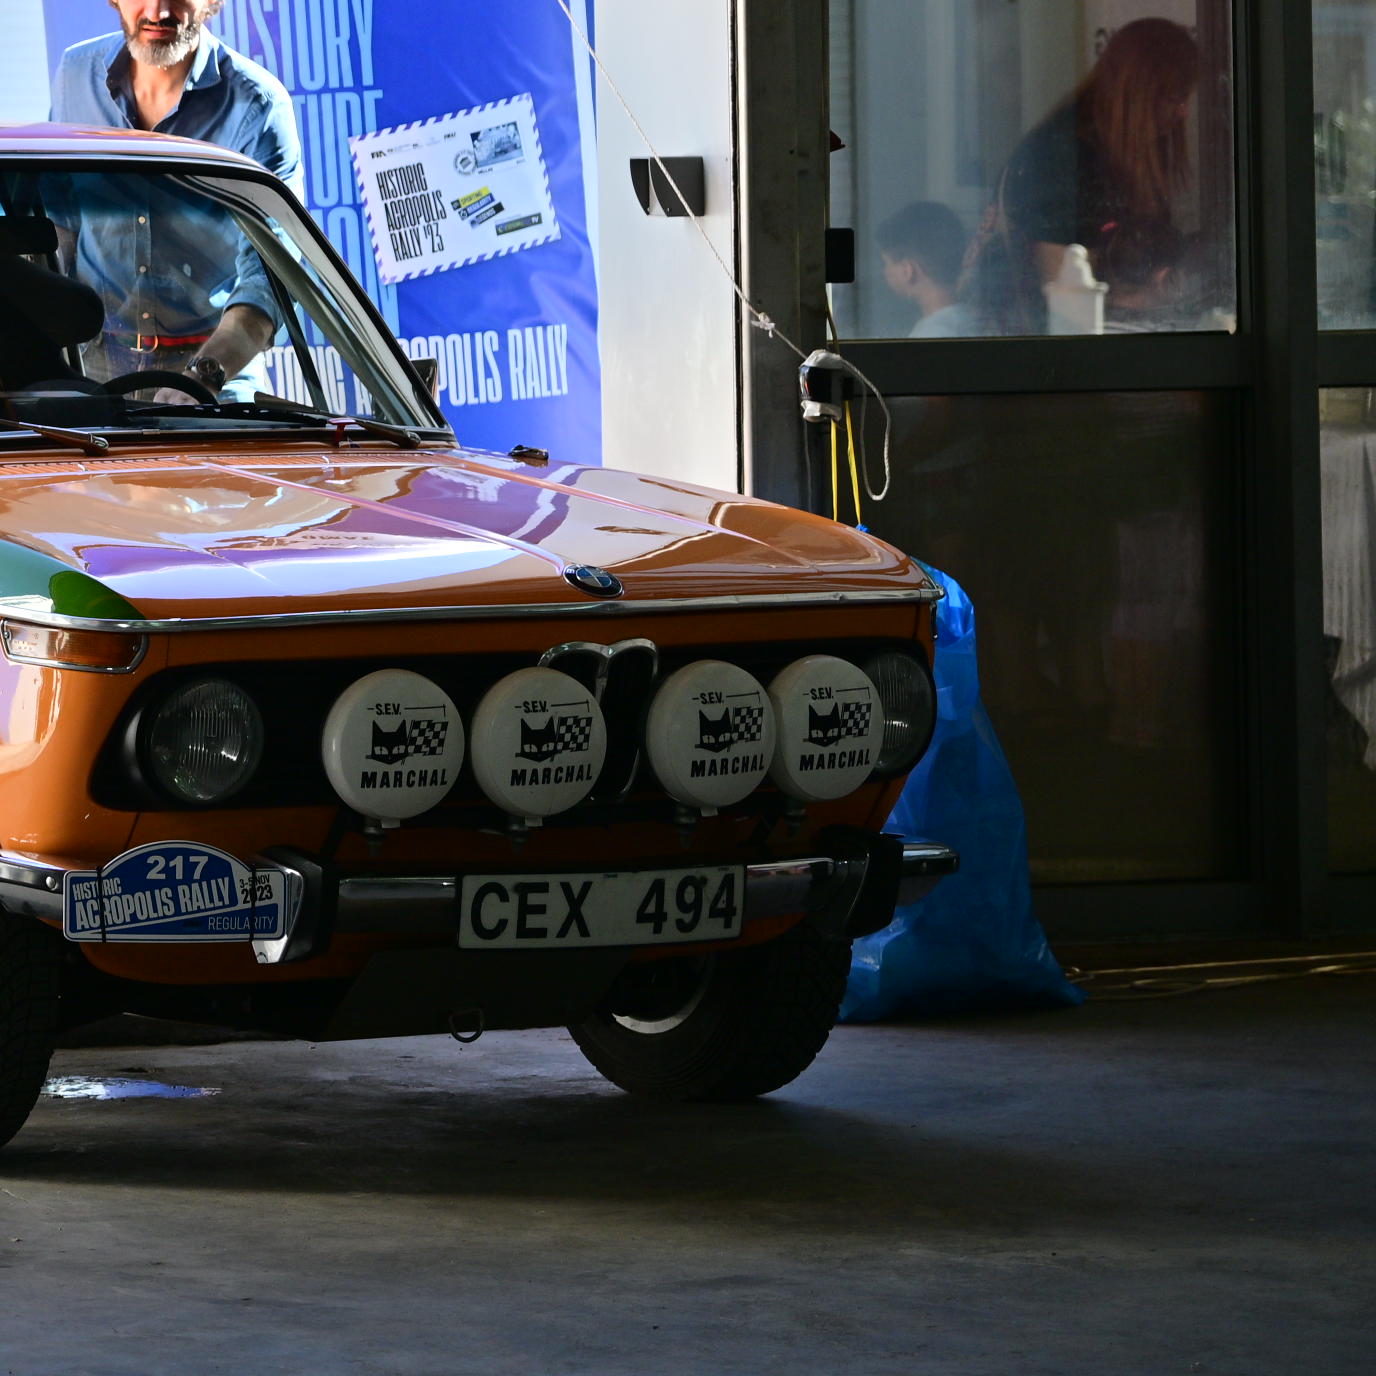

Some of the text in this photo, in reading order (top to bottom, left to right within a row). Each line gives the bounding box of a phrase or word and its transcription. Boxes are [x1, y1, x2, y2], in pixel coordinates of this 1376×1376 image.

[375, 162, 428, 201] HISTORIC
[383, 189, 447, 232] ACROPOLIS
[389, 226, 423, 263] RALLY
[507, 323, 569, 401] RALLY
[360, 768, 448, 789] MARCHAL
[510, 764, 593, 786] MARCHAL
[690, 753, 765, 778] MARCHAL
[799, 748, 870, 772] MARCHAL
[146, 855, 209, 880] 217
[178, 876, 230, 913] RALLY
[470, 873, 737, 941] CEX 494
